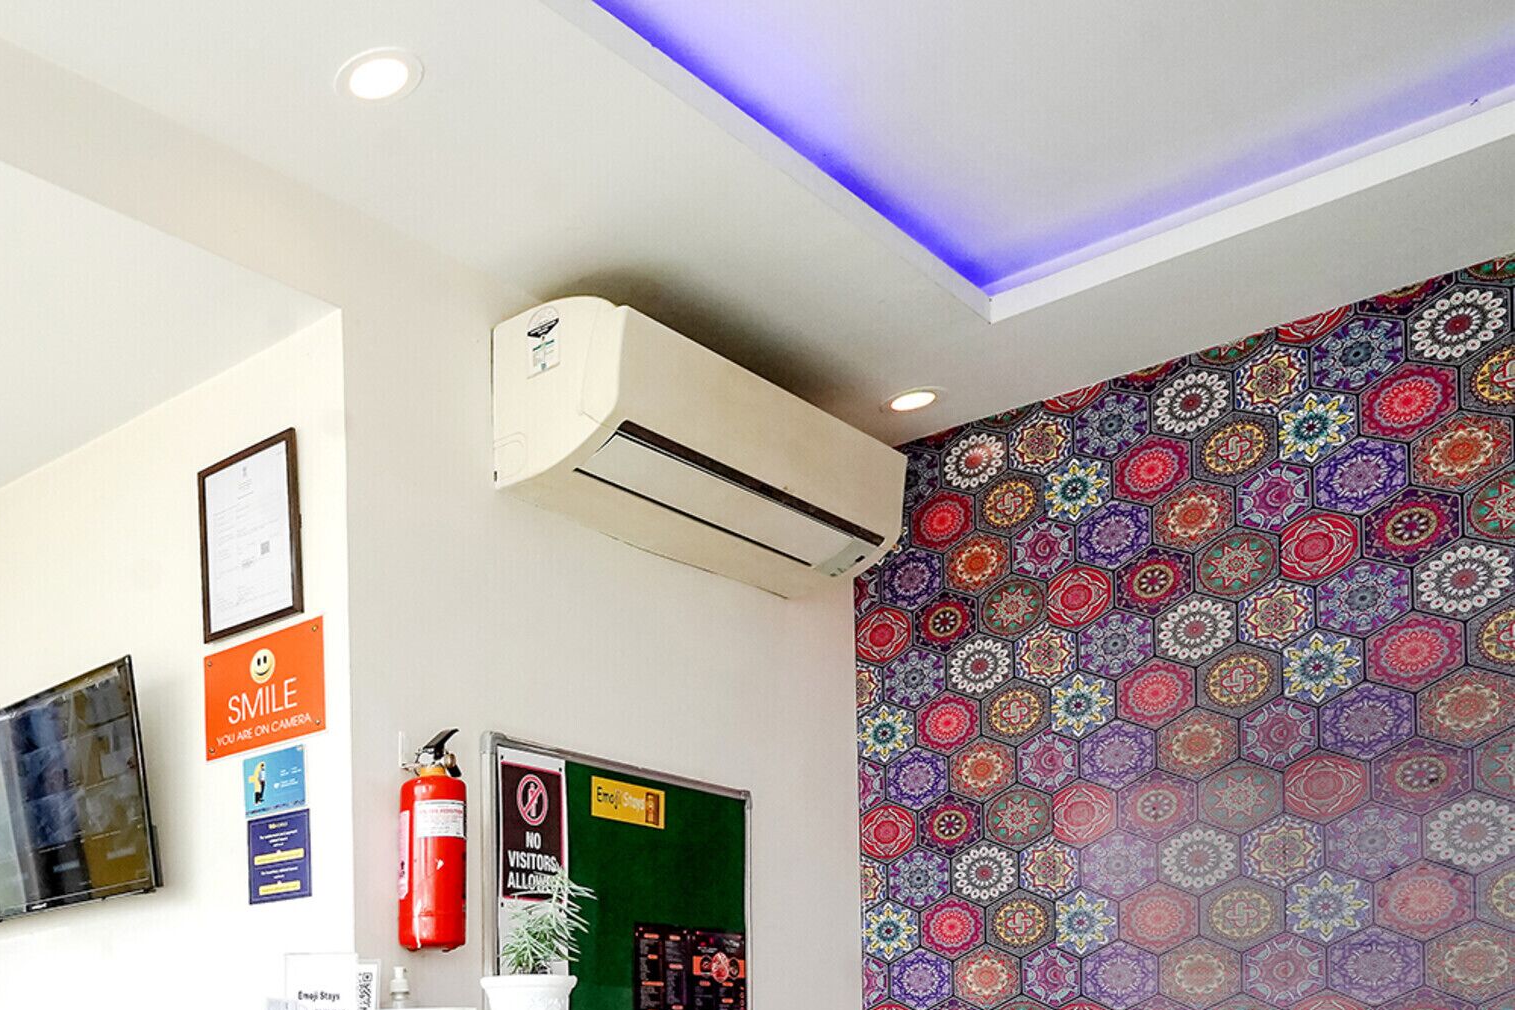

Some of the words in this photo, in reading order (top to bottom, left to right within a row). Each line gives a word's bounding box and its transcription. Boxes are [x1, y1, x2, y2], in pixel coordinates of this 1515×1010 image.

[228, 677, 298, 725] SMILE
[216, 733, 235, 746] YOU
[237, 728, 253, 741] ARE
[254, 725, 270, 737] ON
[270, 713, 312, 732] CAMERA
[525, 831, 542, 850] NO
[507, 849, 558, 873] VISITORS
[507, 871, 559, 893] ALLOW
[319, 990, 341, 1002] Stays
